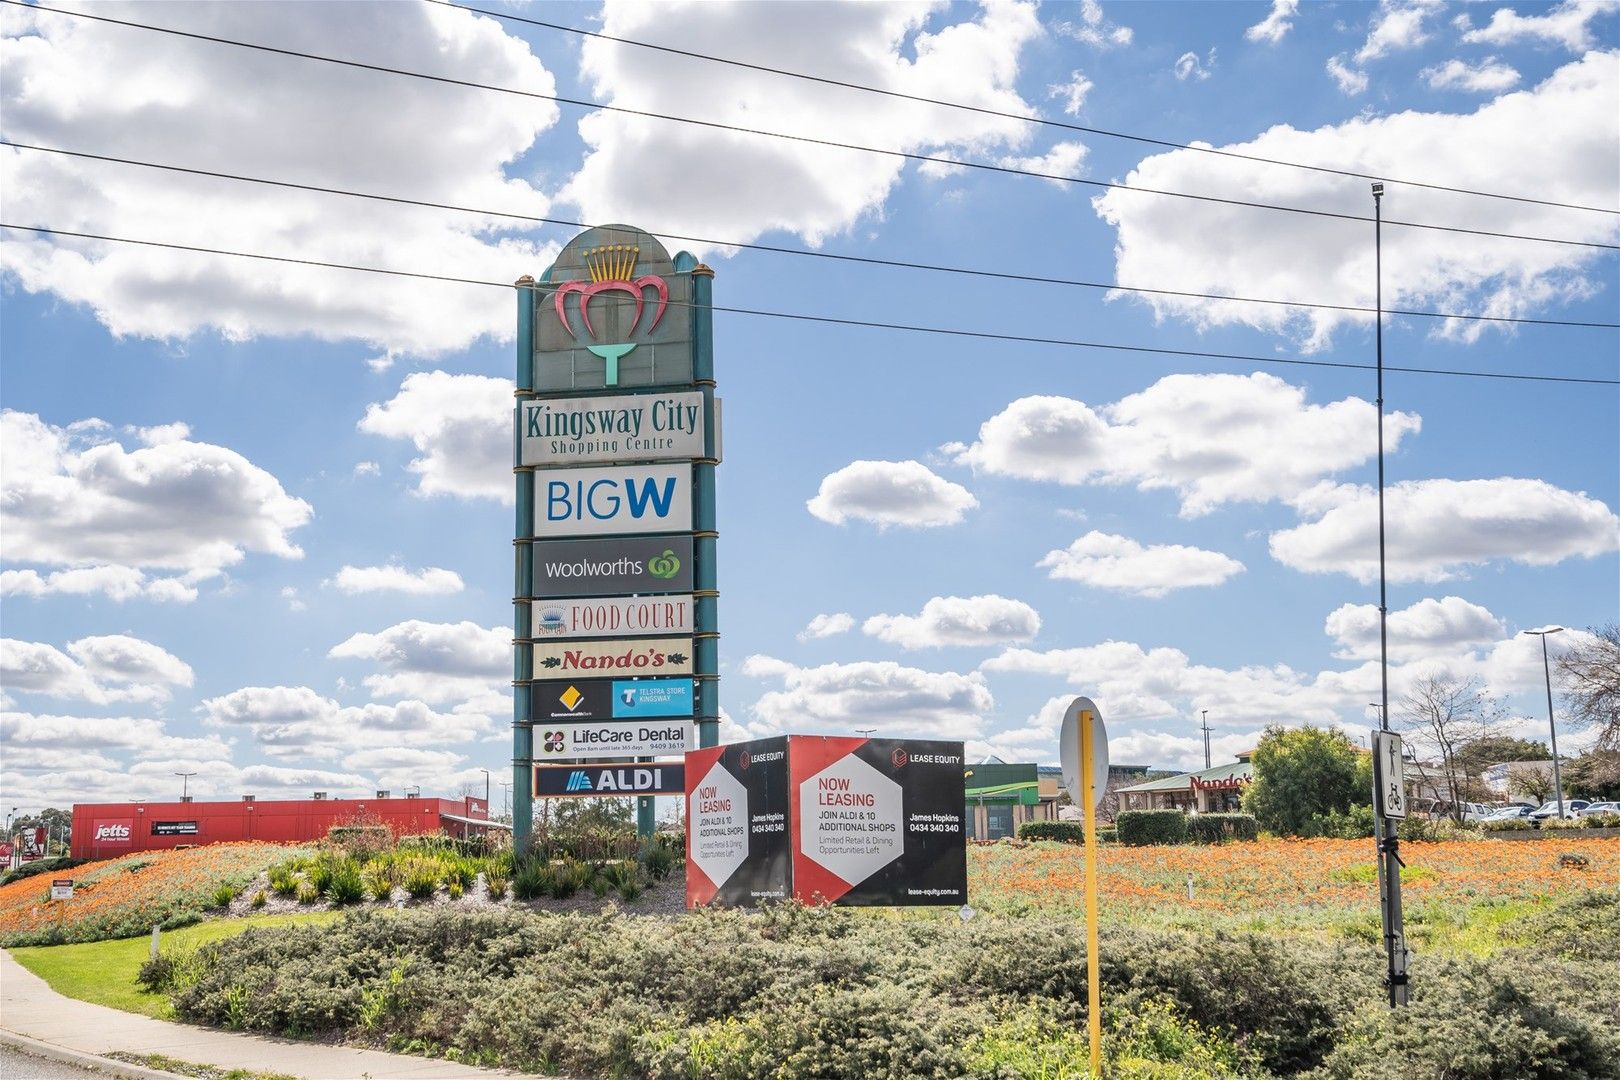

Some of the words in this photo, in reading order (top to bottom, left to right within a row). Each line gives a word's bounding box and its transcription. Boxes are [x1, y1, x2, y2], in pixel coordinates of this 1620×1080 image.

[526, 405, 644, 441] Kingsway
[652, 399, 700, 436] City
[551, 438, 618, 455] Shopping
[626, 437, 673, 450] Centre
[545, 557, 643, 578] Woolworths
[571, 604, 621, 632] FOOD
[626, 602, 686, 629] COURT
[560, 648, 665, 670] Nando's
[639, 688, 666, 696] TELSTRA
[666, 687, 686, 695] STORE
[639, 695, 672, 703] KINGSWAY
[573, 728, 634, 744] LifeCare
[639, 726, 684, 742] Dental
[751, 753, 767, 763] LEASE
[766, 751, 785, 761] EQUITY
[910, 754, 933, 763] LEASE
[934, 755, 961, 764] EQUITY
[596, 768, 662, 791] ALDI
[818, 777, 850, 791] NOW
[699, 786, 717, 800] NOW
[818, 793, 875, 807] LEASING
[699, 799, 732, 814] LEASING
[699, 818, 710, 827] JOIN
[711, 817, 721, 826] ALDI
[721, 816, 726, 825] &
[726, 816, 732, 824] 10
[751, 814, 766, 823] James
[766, 812, 785, 822] Hopkins
[818, 811, 838, 820] JOIN
[839, 811, 858, 820] ALDI
[858, 811, 865, 820] &
[866, 812, 876, 820] 10
[909, 813, 932, 823] James
[932, 813, 959, 825] Hopkins
[95, 824, 130, 840] jetts
[699, 828, 727, 838] ADDITIONAL
[727, 826, 745, 836] SHOPS
[751, 824, 765, 833] 0434
[765, 823, 775, 832] 340
[774, 823, 785, 832] 340
[818, 822, 867, 832] ADDITIONAL
[868, 823, 896, 832] SHOPS
[909, 824, 929, 832] 0434
[930, 824, 944, 833] 340
[944, 824, 959, 833] 340
[819, 836, 844, 845] Limited
[845, 836, 865, 845] Retail
[865, 836, 871, 845] &
[872, 836, 893, 847] Dining
[819, 846, 865, 856] Opportunities
[865, 846, 880, 854] Left
[907, 888, 960, 897] lease-equity.com.au
